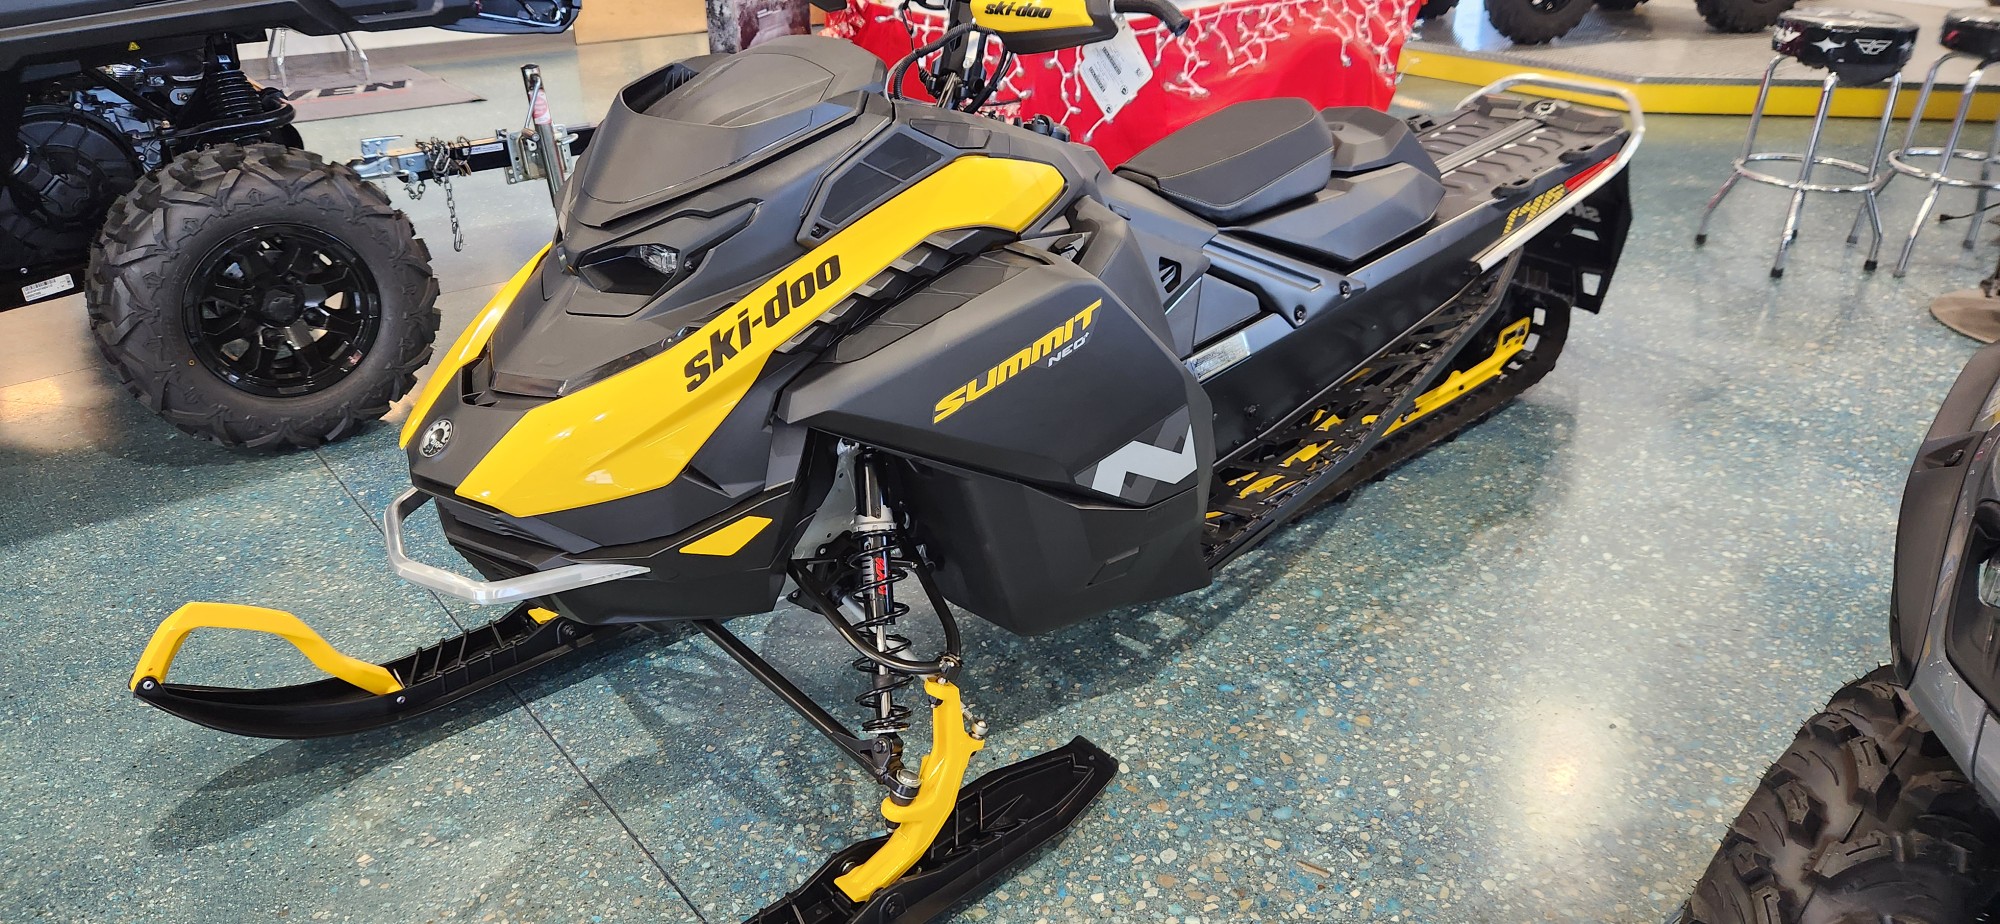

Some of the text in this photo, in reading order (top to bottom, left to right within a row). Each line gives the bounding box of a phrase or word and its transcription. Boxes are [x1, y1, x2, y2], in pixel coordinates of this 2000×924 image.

[984, 1, 1053, 18] ski-doo
[684, 254, 841, 393] ski-doo
[933, 298, 1102, 424] SUMMIT
